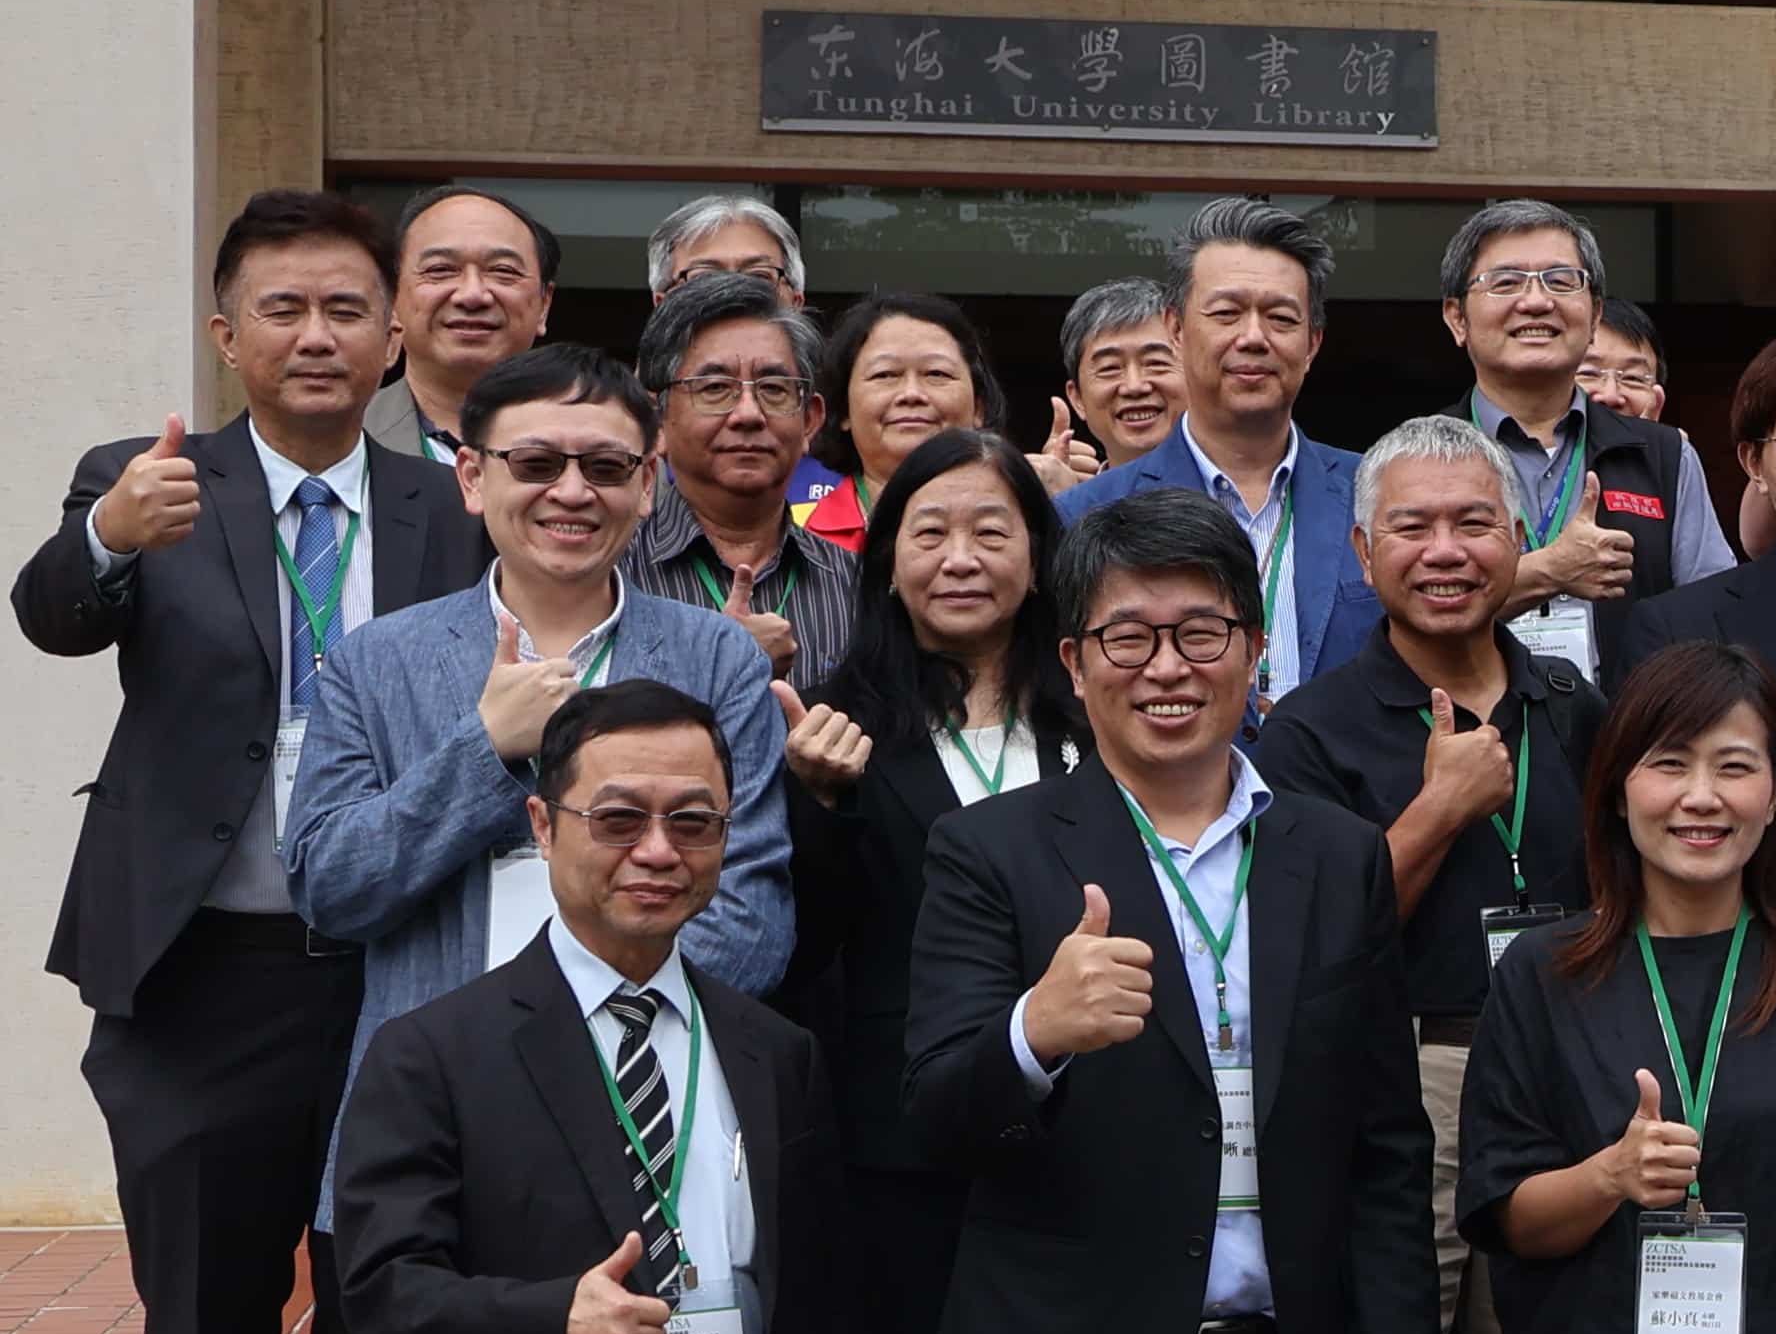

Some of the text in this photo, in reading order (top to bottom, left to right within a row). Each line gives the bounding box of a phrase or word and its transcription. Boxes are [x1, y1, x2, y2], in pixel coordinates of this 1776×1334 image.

[808, 89, 1396, 135] Tunghai University Library
